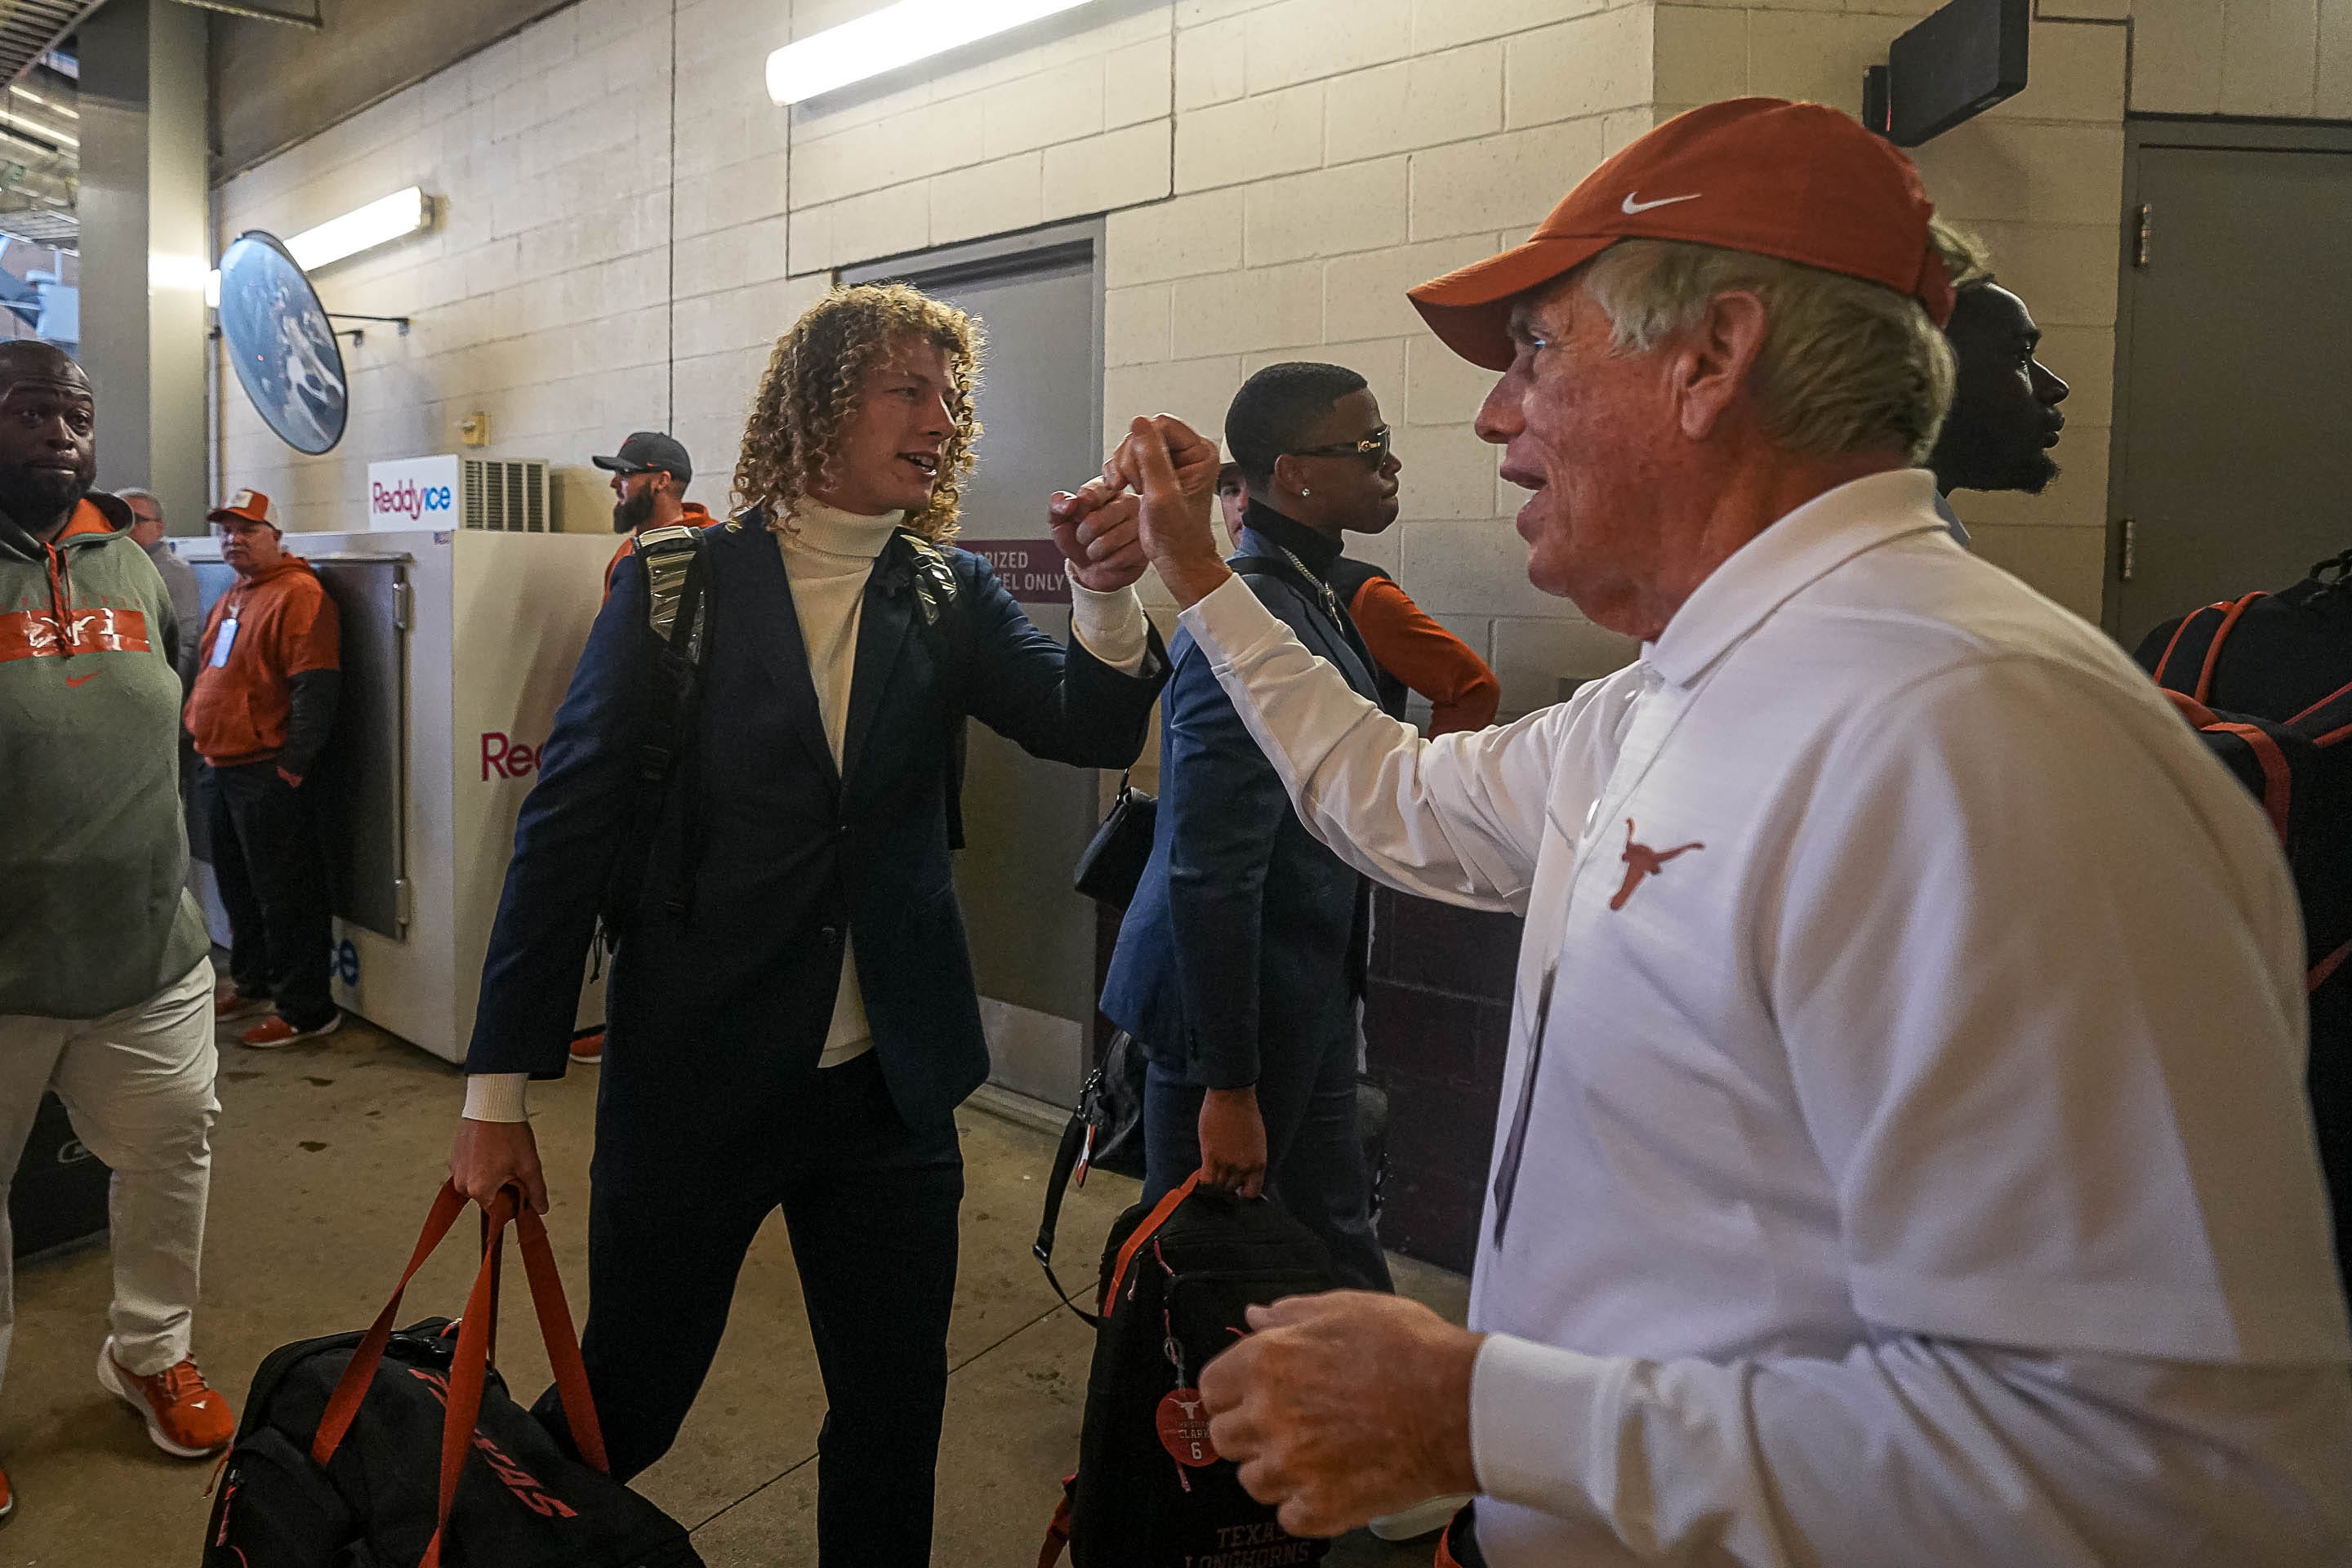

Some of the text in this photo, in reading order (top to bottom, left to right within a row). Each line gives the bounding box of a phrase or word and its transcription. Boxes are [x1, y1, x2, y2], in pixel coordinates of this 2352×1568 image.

[975, 550, 1029, 569] RIZED
[1024, 573, 1065, 591] ONLY
[1191, 1441, 1202, 1460] 6
